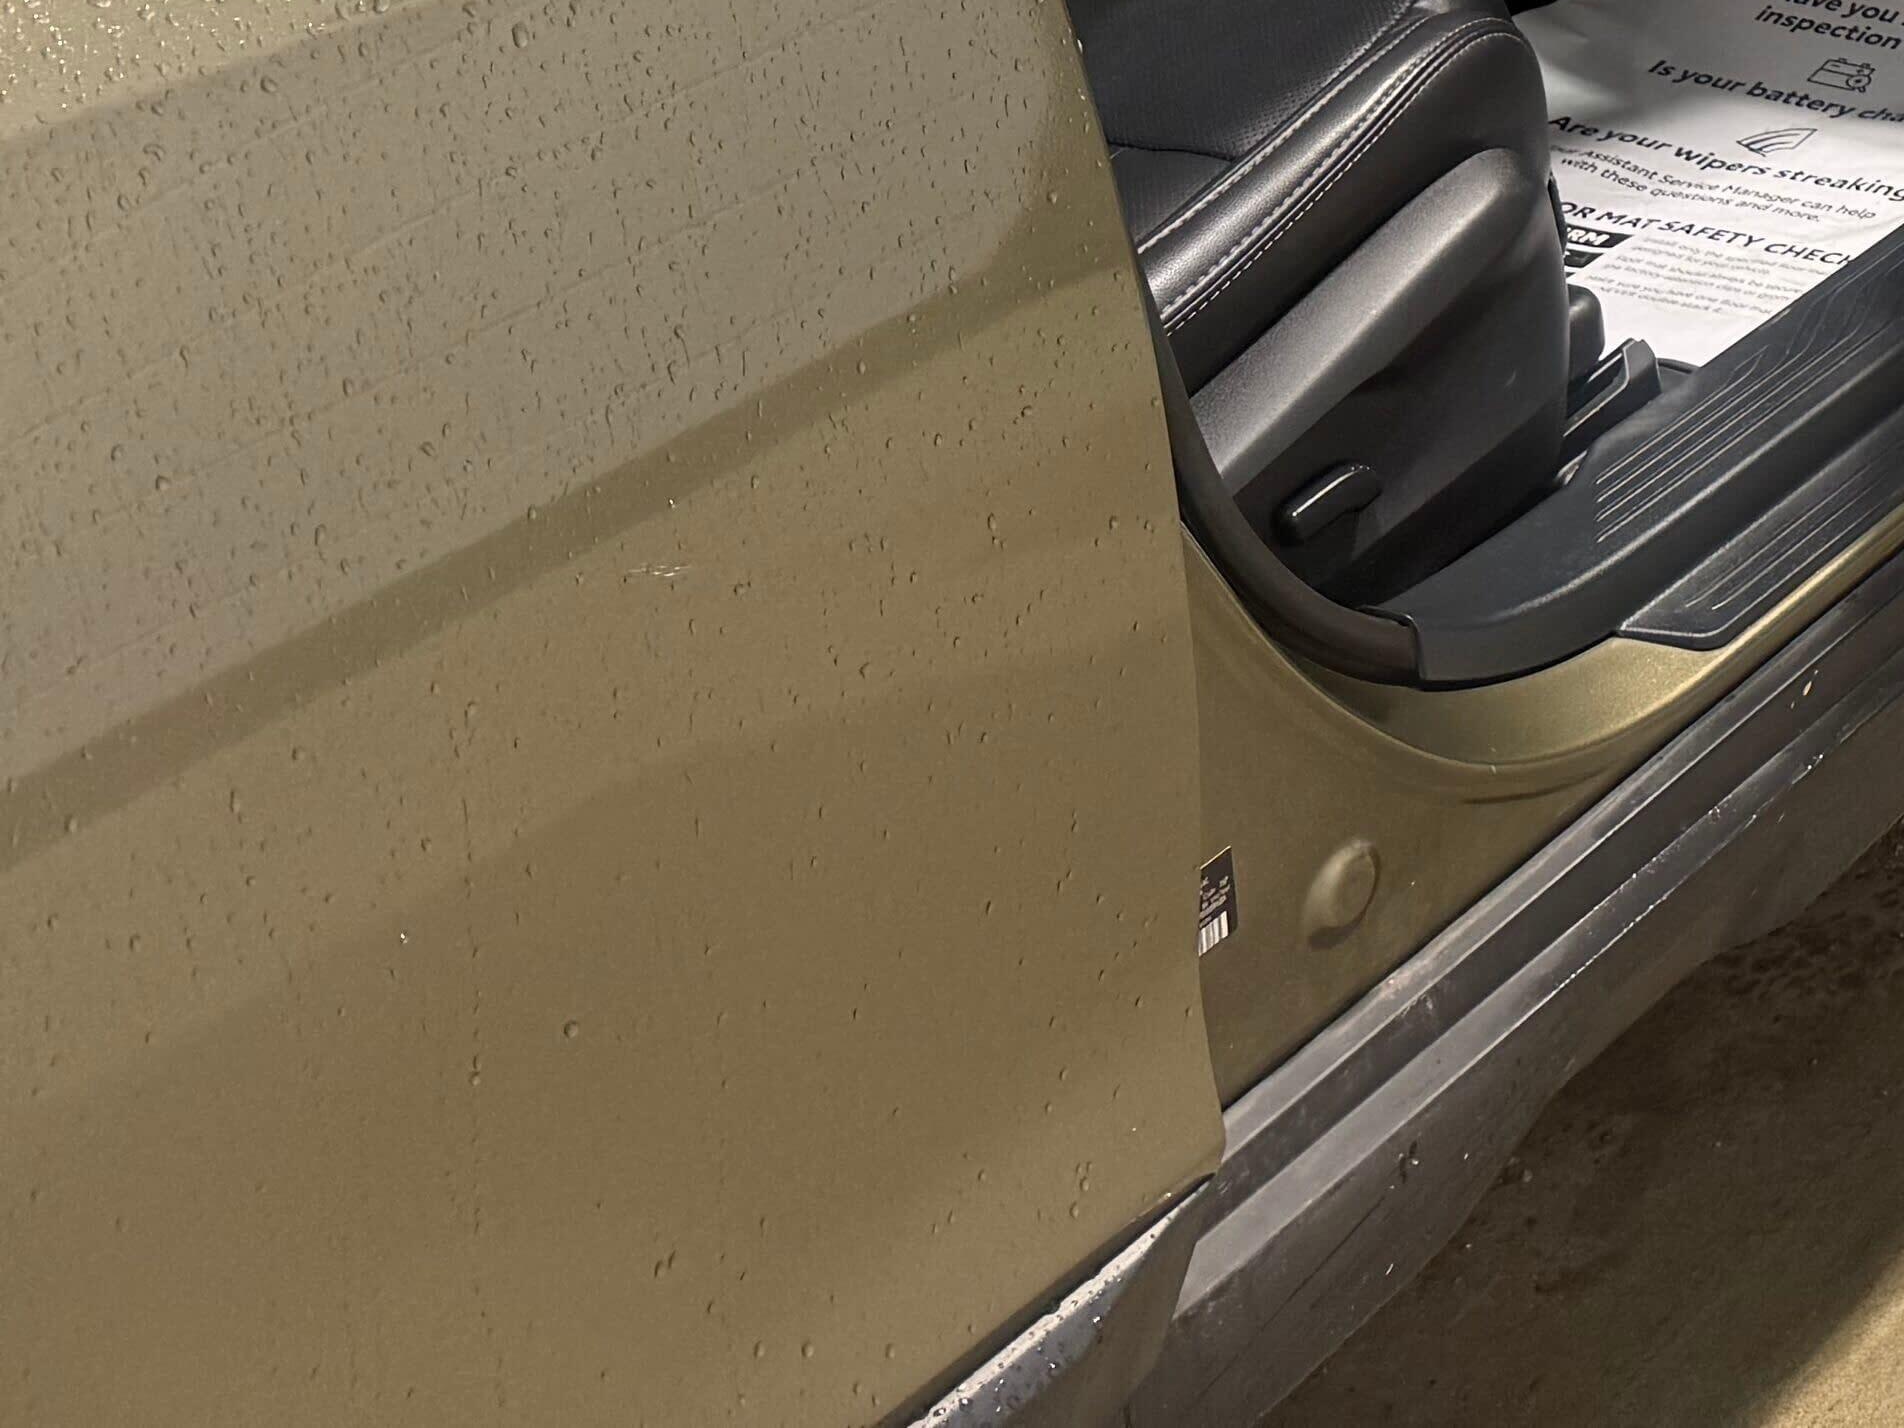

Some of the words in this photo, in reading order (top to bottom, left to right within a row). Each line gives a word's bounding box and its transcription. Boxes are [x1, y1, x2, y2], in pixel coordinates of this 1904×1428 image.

[1753, 5, 1902, 52] inspection
[1841, 2, 1900, 24] you
[1648, 60, 1674, 77] Is
[1672, 70, 1746, 94] your
[1745, 81, 1854, 120] battery
[1547, 116, 1600, 137] Are
[1596, 130, 1673, 151] your
[1673, 146, 1772, 176] wipers
[1561, 157, 1599, 174] with
[1600, 169, 1648, 192] these
[1649, 187, 1733, 207] questions
[1734, 199, 1774, 213] and
[1772, 206, 1821, 224] more.
[1578, 150, 1659, 181] Assistant
[1657, 173, 1721, 192] Service
[1721, 184, 1800, 206] Manager
[1800, 199, 1833, 213] can
[1834, 204, 1877, 221] help
[1560, 201, 1597, 220] OR
[1595, 211, 1662, 230] MAT
[1657, 220, 1767, 248] SAFETY
